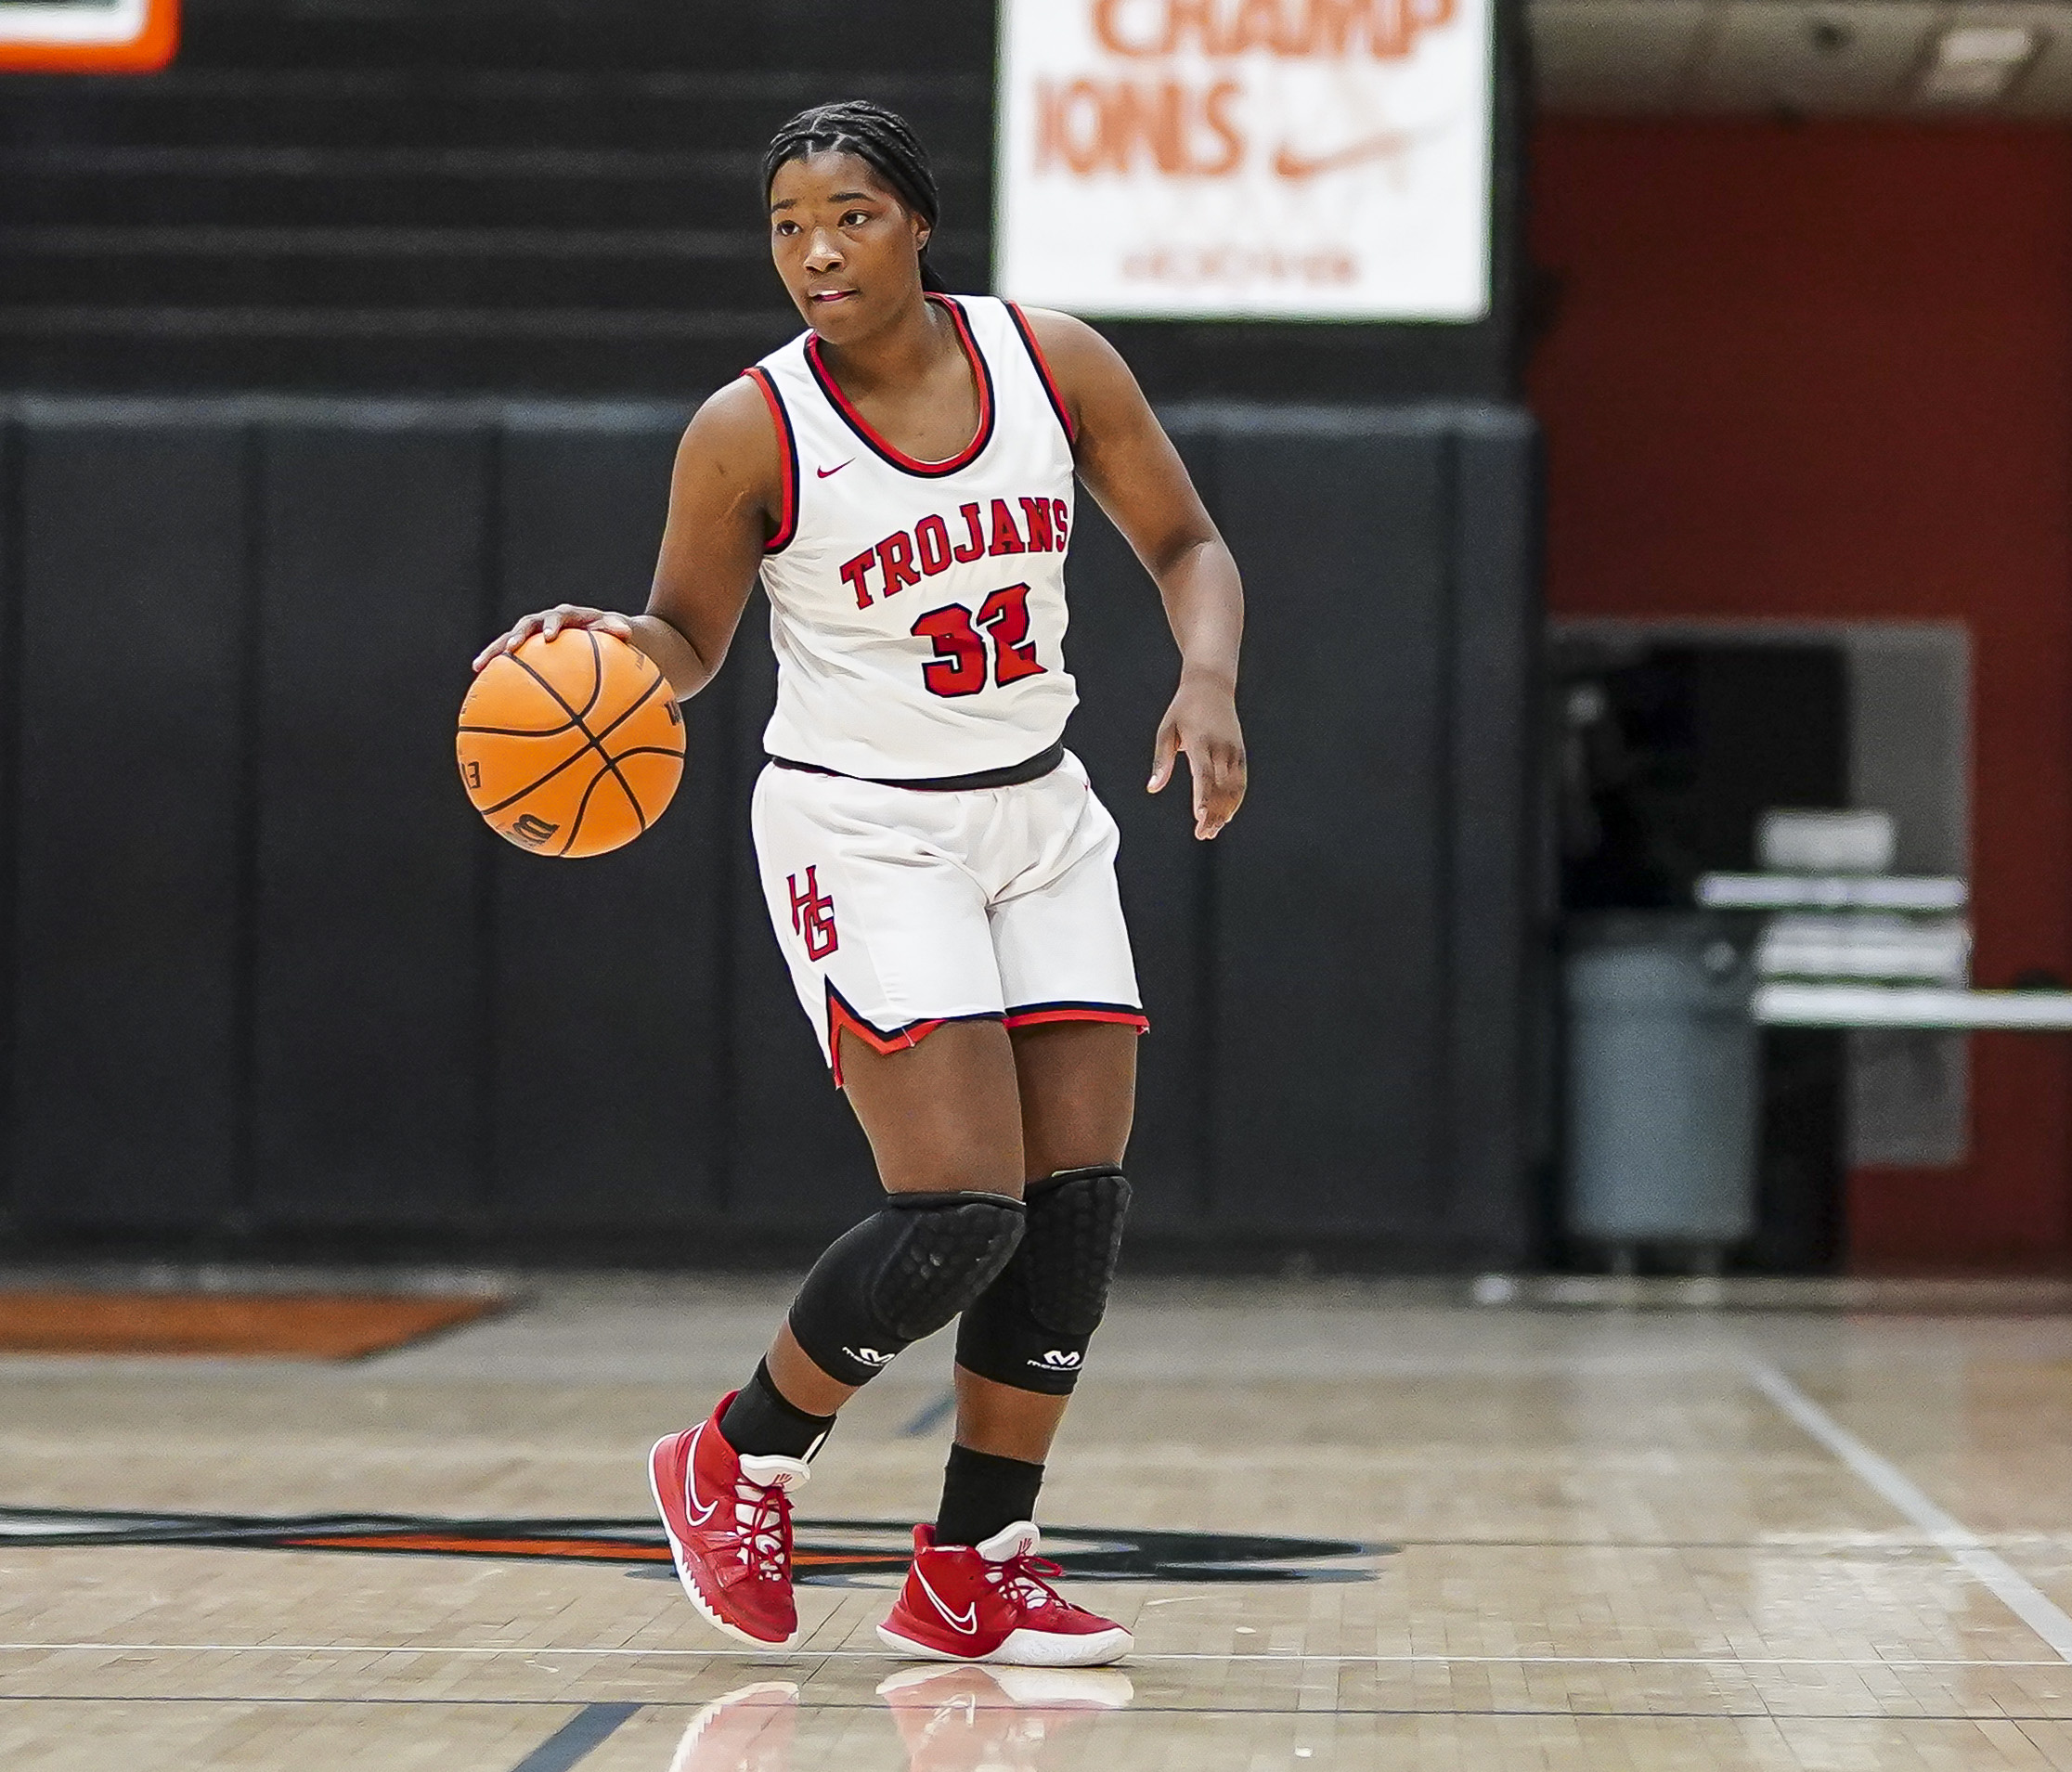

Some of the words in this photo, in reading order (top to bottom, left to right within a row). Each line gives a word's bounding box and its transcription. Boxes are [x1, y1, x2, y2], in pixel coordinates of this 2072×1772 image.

[1032, 78, 1245, 176] IONS
[839, 497, 1068, 610] TROJANS
[910, 582, 1049, 697] 32
